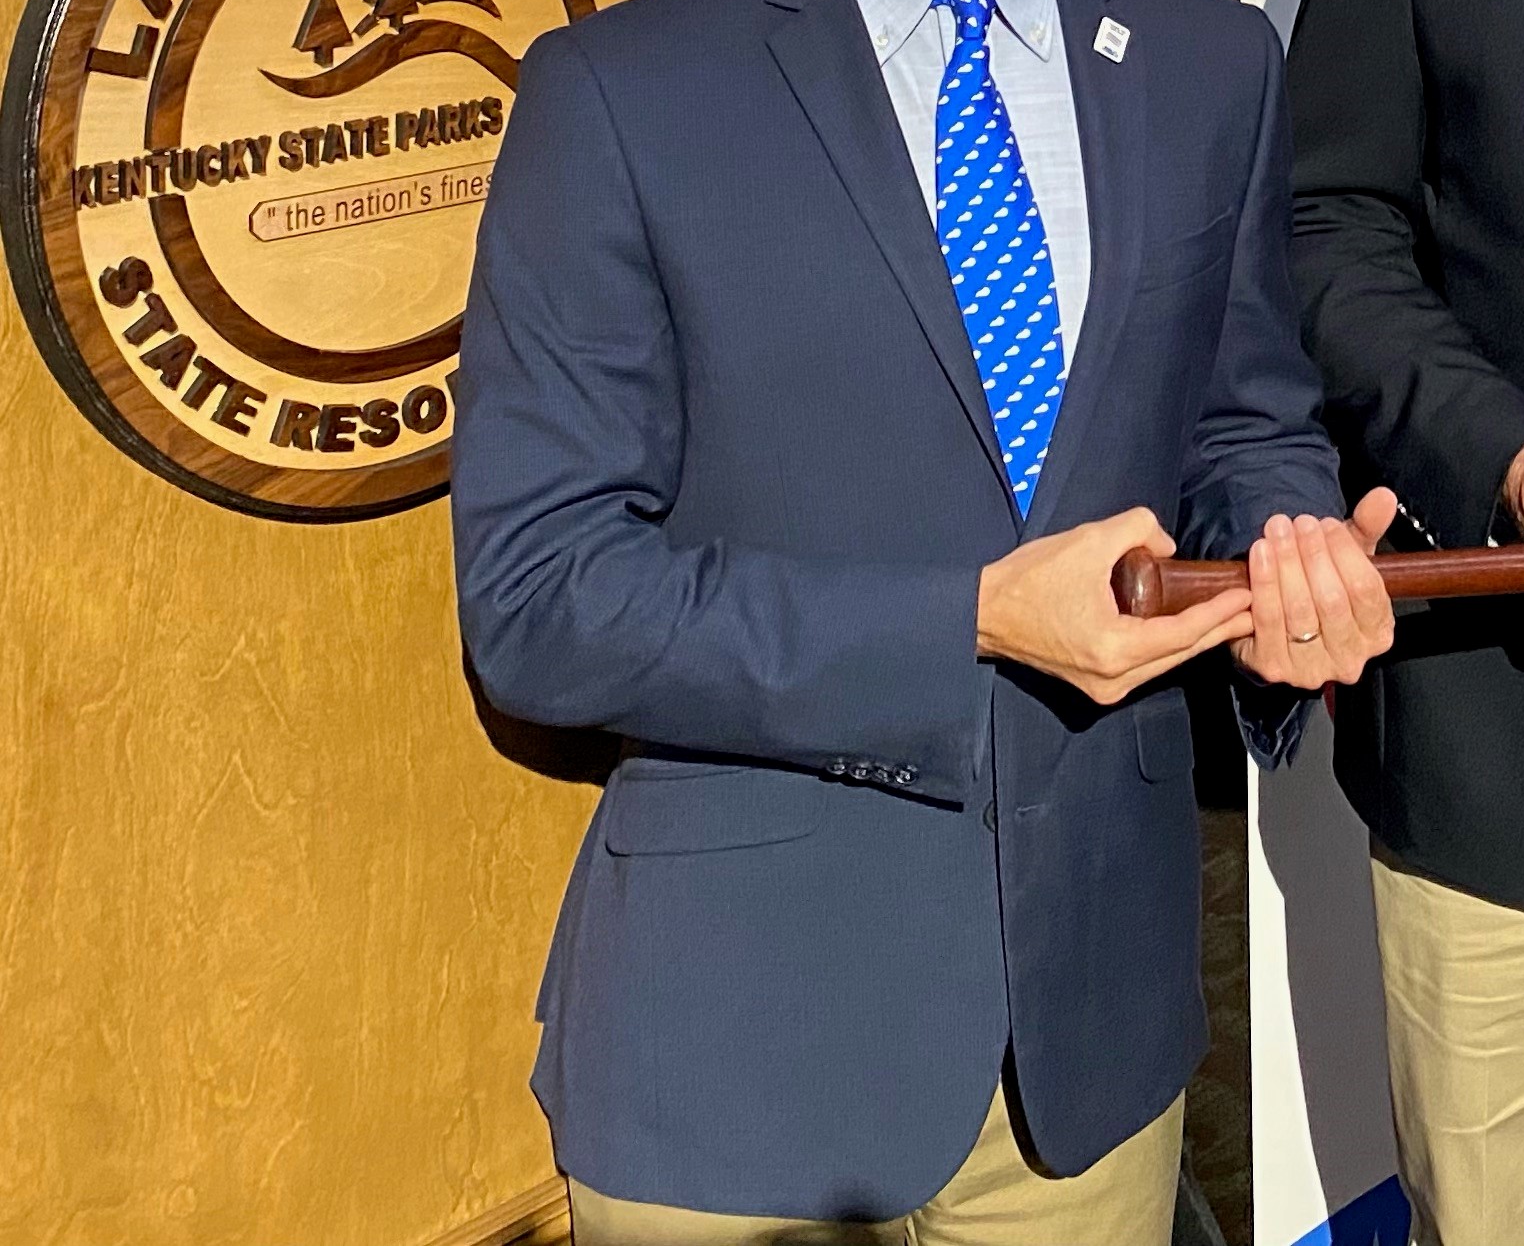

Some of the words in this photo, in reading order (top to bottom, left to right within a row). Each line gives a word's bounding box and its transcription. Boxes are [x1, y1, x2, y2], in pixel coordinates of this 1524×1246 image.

[72, 134, 272, 210] KENTUCKY
[278, 116, 391, 172] STATE
[396, 96, 503, 152] PARKS
[286, 202, 325, 231] the
[335, 181, 432, 222] nation's
[99, 256, 267, 437] STATE
[270, 369, 460, 452] RESO
